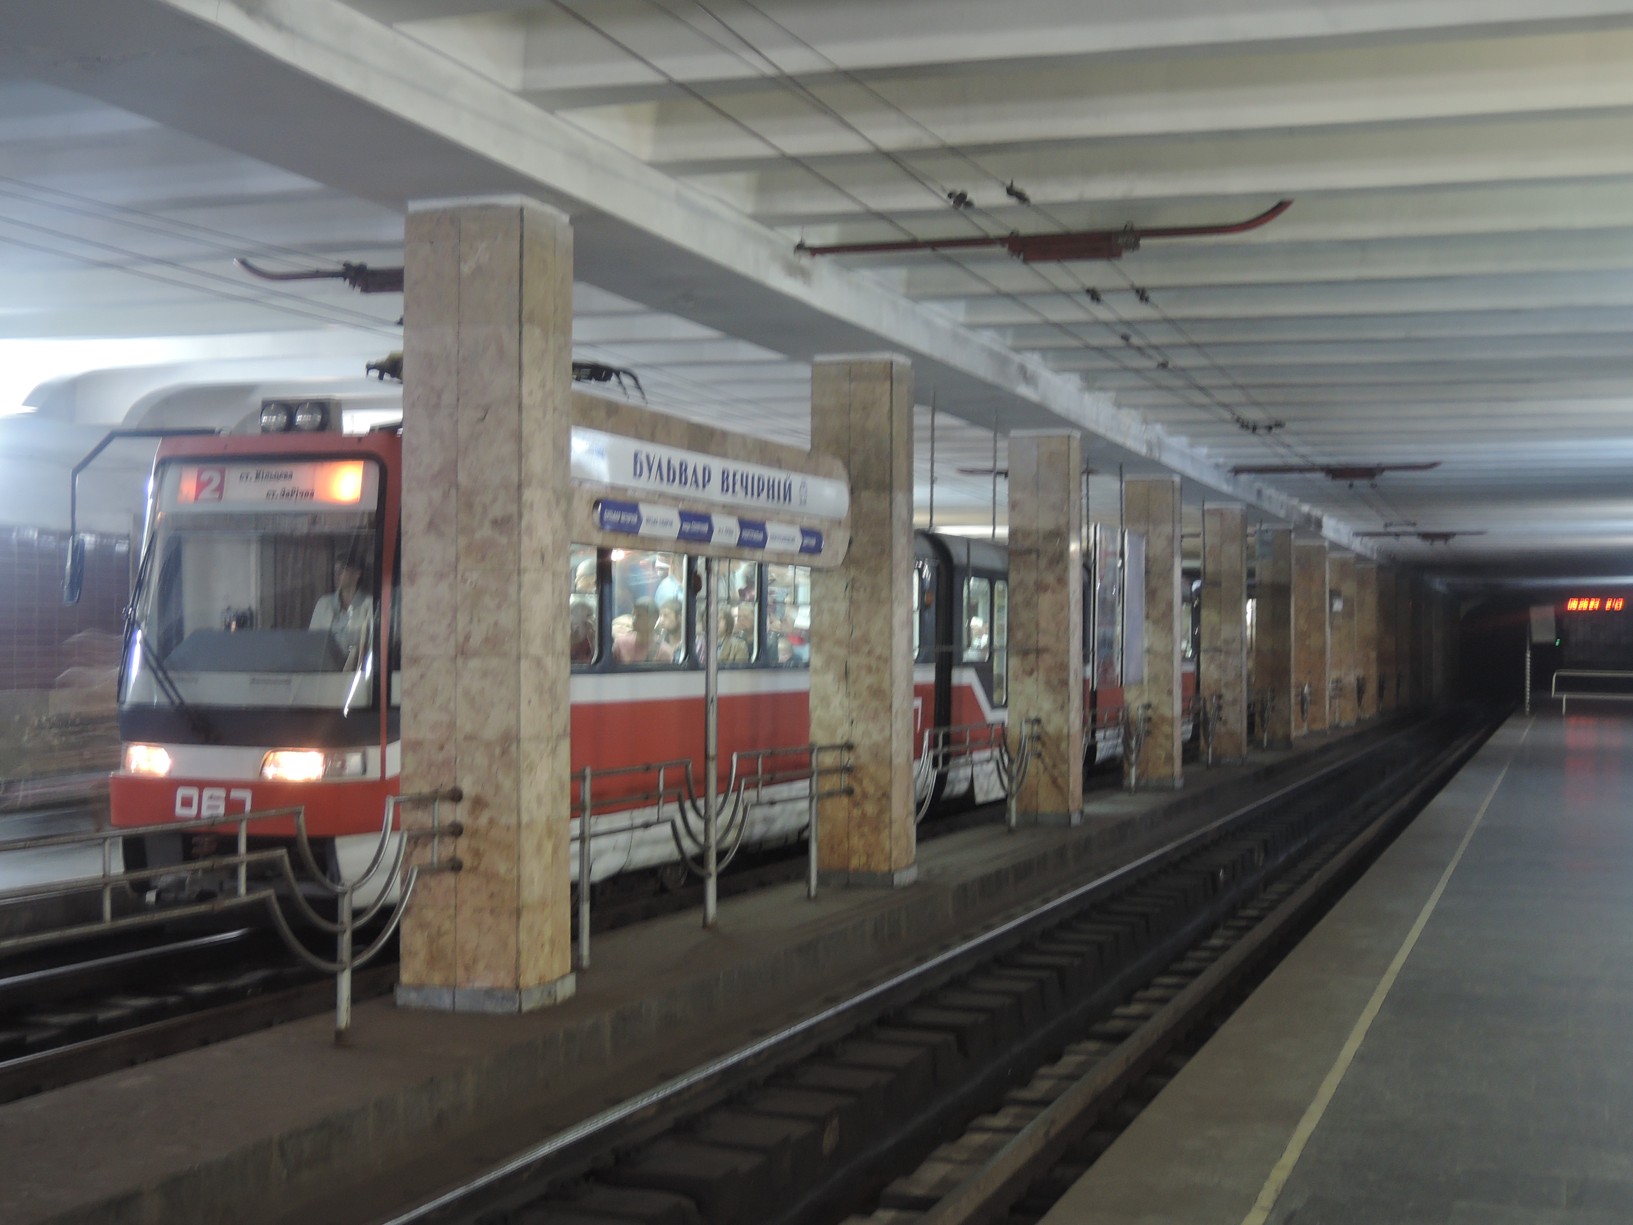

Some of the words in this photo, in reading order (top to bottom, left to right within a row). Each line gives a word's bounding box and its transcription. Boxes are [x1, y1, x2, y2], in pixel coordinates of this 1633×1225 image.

[198, 469, 222, 501] 2
[632, 450, 712, 492] БУЛЬВАР
[720, 466, 792, 504] ВЕЧІРНІЙ
[175, 786, 252, 818] 067
